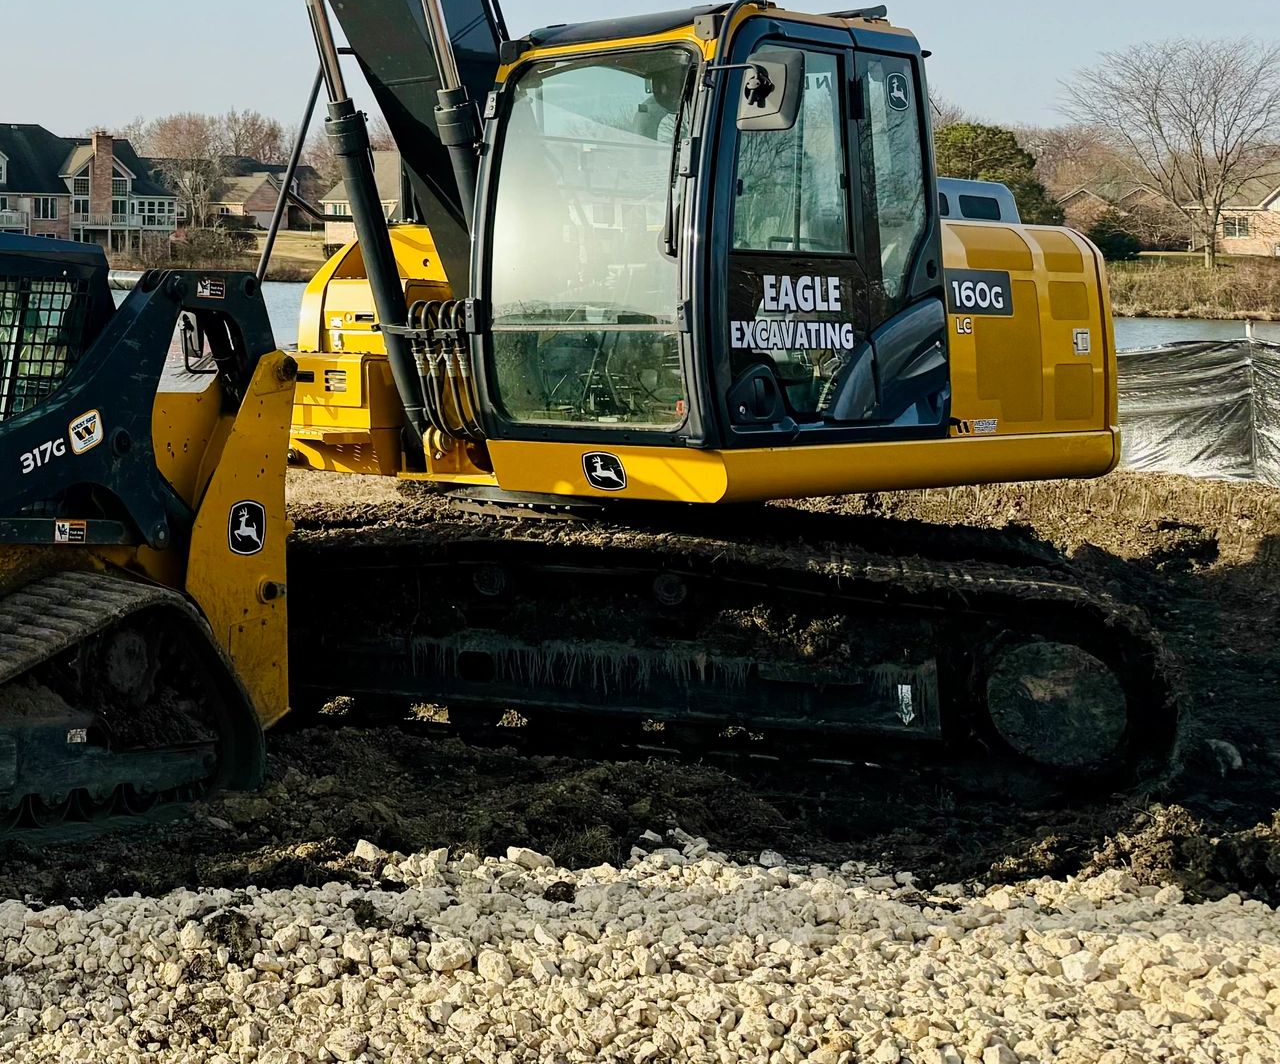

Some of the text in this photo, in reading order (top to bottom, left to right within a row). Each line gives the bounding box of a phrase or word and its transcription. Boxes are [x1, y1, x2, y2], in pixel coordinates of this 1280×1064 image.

[763, 274, 842, 312] EAGLE
[952, 280, 1004, 309] 160G
[730, 320, 854, 350] EXCAVATING
[956, 317, 972, 334] LC
[20, 437, 66, 474] 317G
